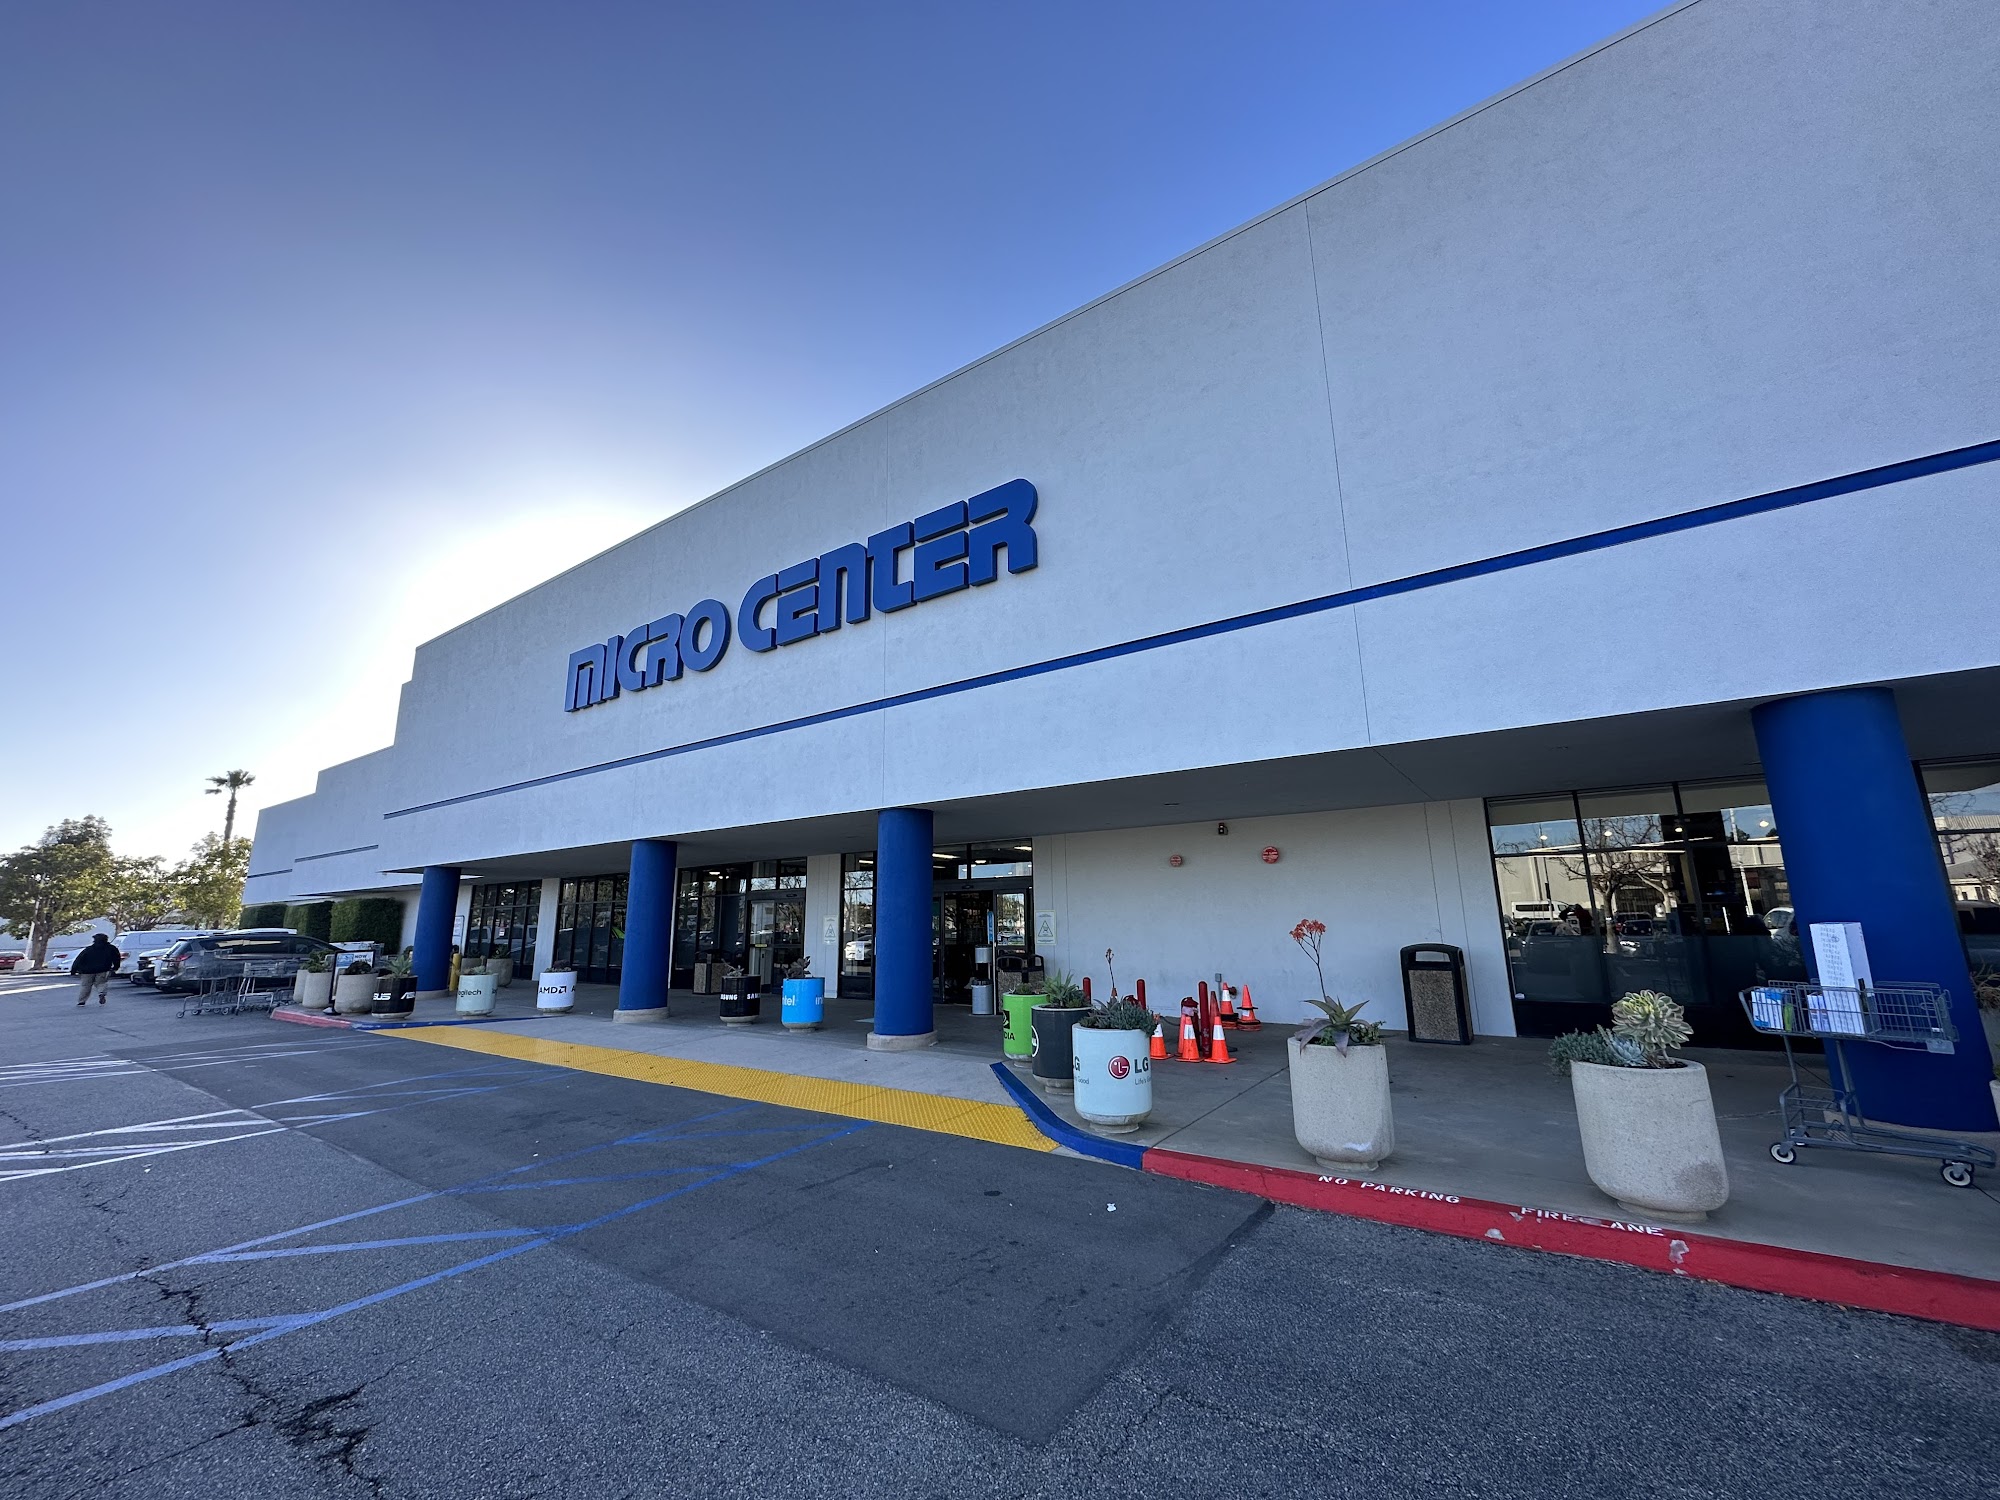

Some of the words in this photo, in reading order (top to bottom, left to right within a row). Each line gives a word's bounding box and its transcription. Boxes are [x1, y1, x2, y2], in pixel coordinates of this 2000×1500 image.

[565, 598, 732, 713] MICRO
[738, 478, 1039, 653] CENTER
[373, 992, 391, 1001] SUS
[458, 989, 482, 997] ogitech
[539, 986, 558, 994] AMD
[1134, 1056, 1149, 1074] LG
[1318, 1175, 1348, 1185] NO
[1360, 1181, 1460, 1204] PARKING
[1521, 1207, 1577, 1223] FIRE
